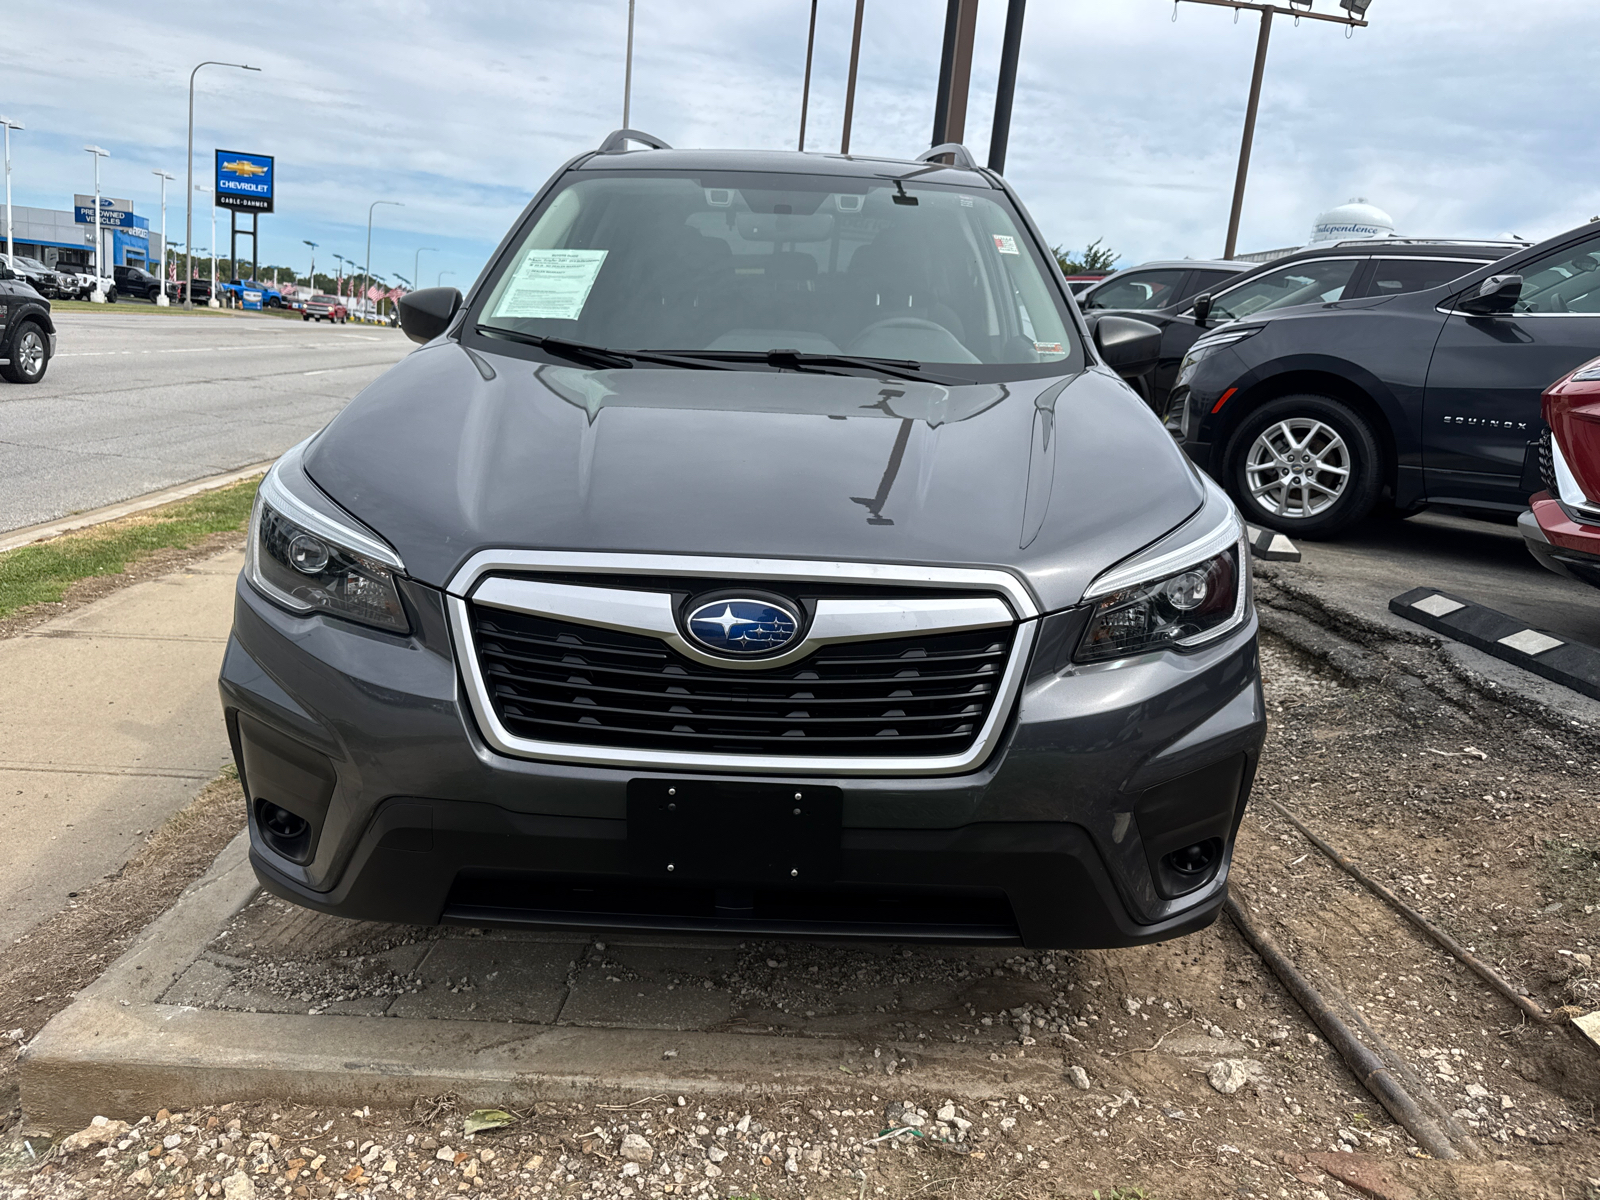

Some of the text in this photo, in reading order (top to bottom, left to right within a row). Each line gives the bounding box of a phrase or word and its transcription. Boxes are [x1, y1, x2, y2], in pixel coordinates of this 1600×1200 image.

[220, 180, 268, 192] CHEVROLET
[221, 197, 268, 208] CABLE-DAHMER
[86, 216, 120, 226] VEICLES
[1443, 416, 1527, 430] EQUINOX
